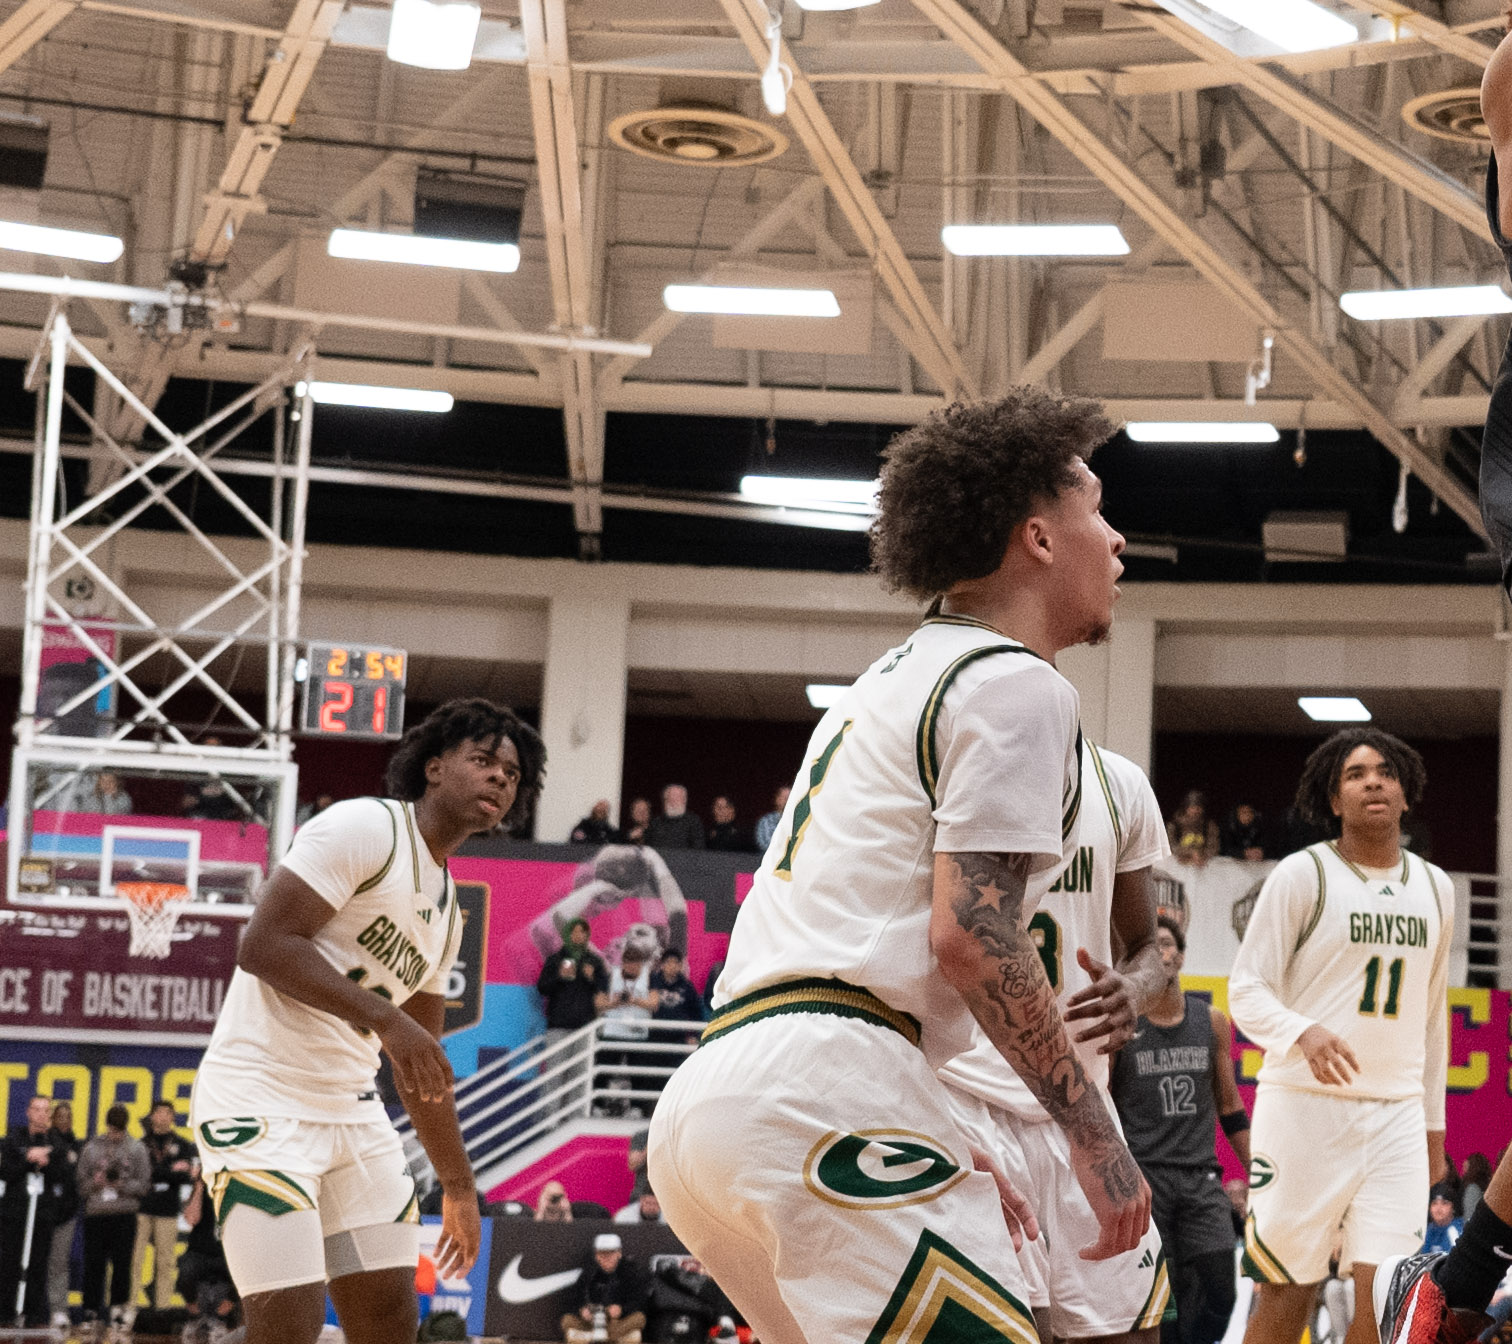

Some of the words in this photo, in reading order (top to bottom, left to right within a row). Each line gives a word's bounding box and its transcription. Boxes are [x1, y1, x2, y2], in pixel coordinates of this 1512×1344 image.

[319, 681, 387, 733] 21
[774, 718, 854, 882] 1
[357, 914, 430, 992] GRAYSON
[1350, 912, 1428, 948] GRAYSON
[40, 969, 74, 1015] OF
[1358, 954, 1405, 1020] 11
[1160, 1075, 1197, 1115] 12
